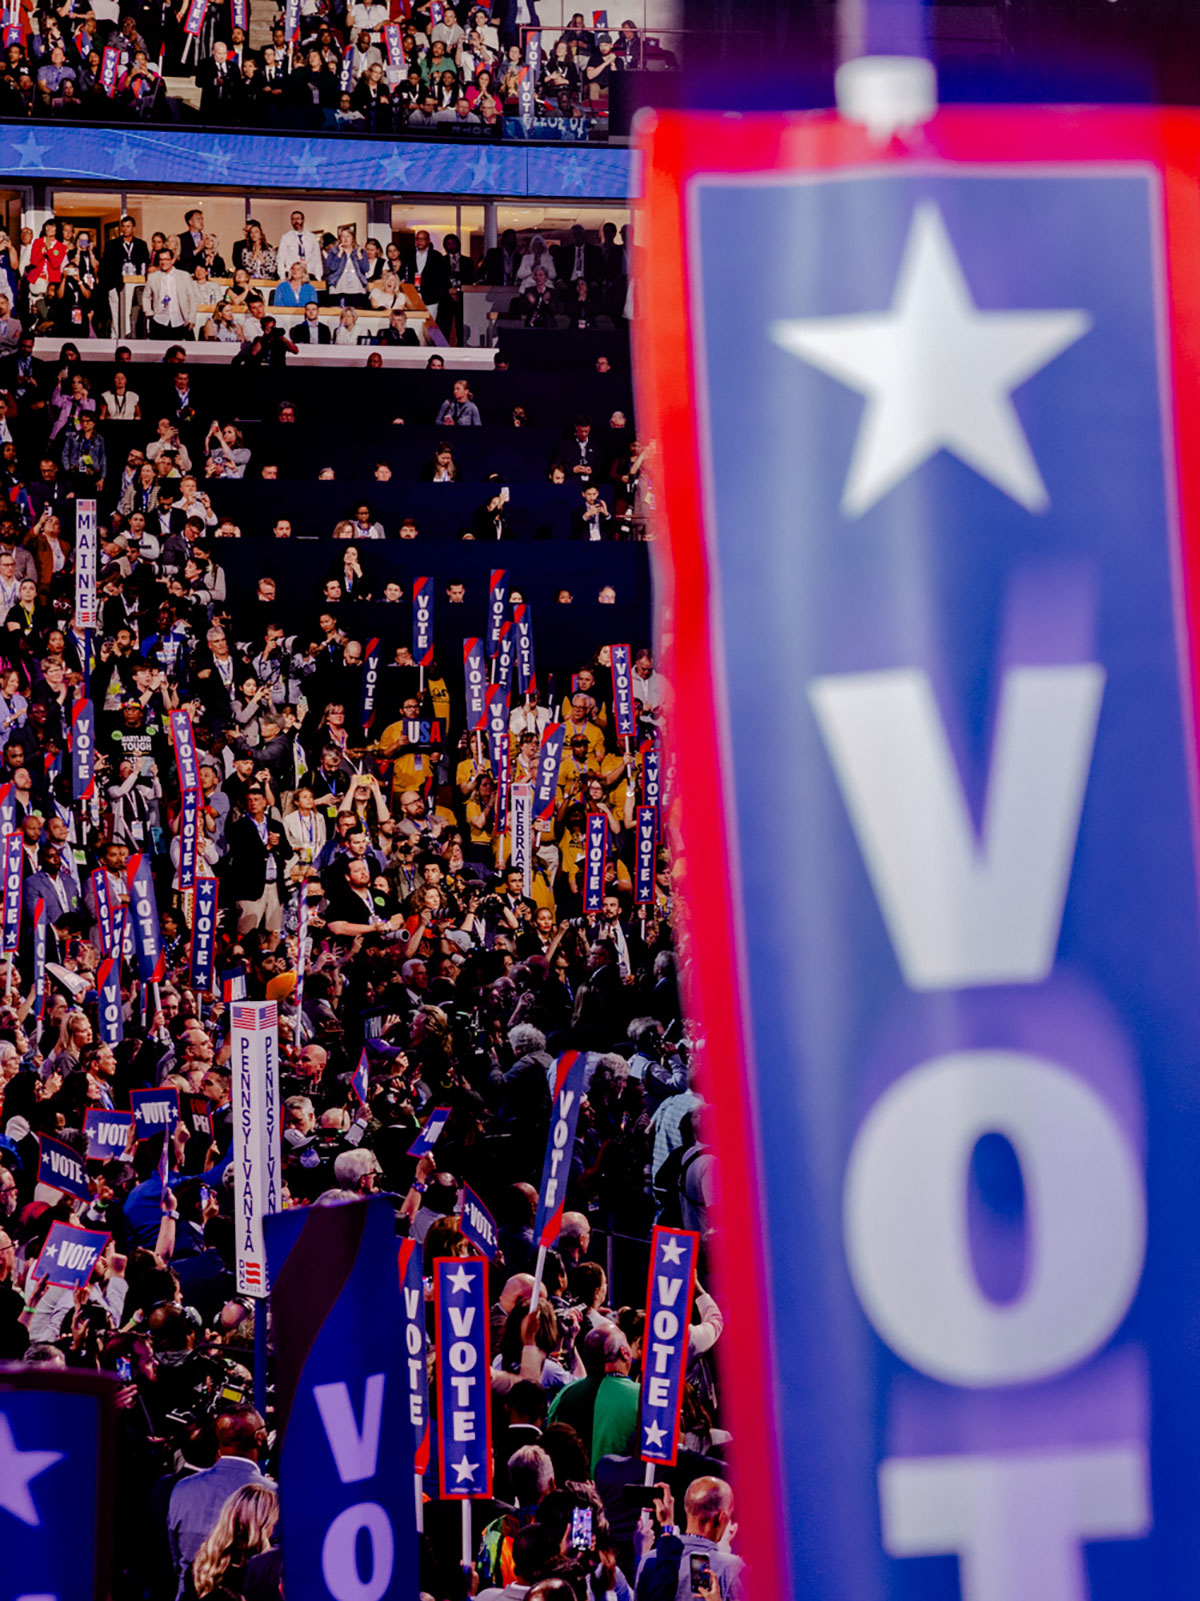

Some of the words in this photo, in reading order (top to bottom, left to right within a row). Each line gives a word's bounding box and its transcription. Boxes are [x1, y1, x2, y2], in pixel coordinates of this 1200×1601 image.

[340, 60, 352, 91] VOT
[389, 37, 402, 65] VOT
[529, 41, 539, 69] VOT
[78, 514, 90, 609] MAINE
[417, 595, 430, 649] VOTE
[492, 587, 505, 641] VOTE
[519, 622, 531, 676] VOTE
[364, 656, 378, 711] VOTE
[469, 656, 482, 712] VOTE
[616, 662, 630, 715] VOTE
[77, 719, 90, 779] VOTE
[121, 742, 152, 751] TOUGH
[177, 729, 197, 787] VOTE
[407, 720, 442, 743] USA
[539, 742, 559, 801] VOTE
[647, 769, 658, 805] VOT
[183, 808, 197, 866] VOTE
[515, 799, 525, 874] NEBRAS
[590, 833, 603, 890] VOTE
[640, 825, 653, 881] VOTE
[6, 856, 21, 924] VOTE
[133, 880, 156, 957] VOTE
[197, 900, 215, 966] VOTE
[103, 985, 118, 1048] VOT
[141, 1101, 172, 1124] VOTE
[264, 1036, 276, 1214] PENNSYLVAN
[806, 665, 1152, 1601] VOT
[50, 1150, 84, 1185] VOTE
[240, 1038, 255, 1252] PENNSYLVANIA
[545, 1090, 575, 1208] VOTE
[470, 1202, 493, 1246] VOTE
[56, 1240, 96, 1271] VOTE
[404, 1287, 423, 1426] VOTE
[647, 1275, 683, 1408] VOTE
[448, 1307, 477, 1441] VOTE
[313, 1373, 394, 1601] VO
